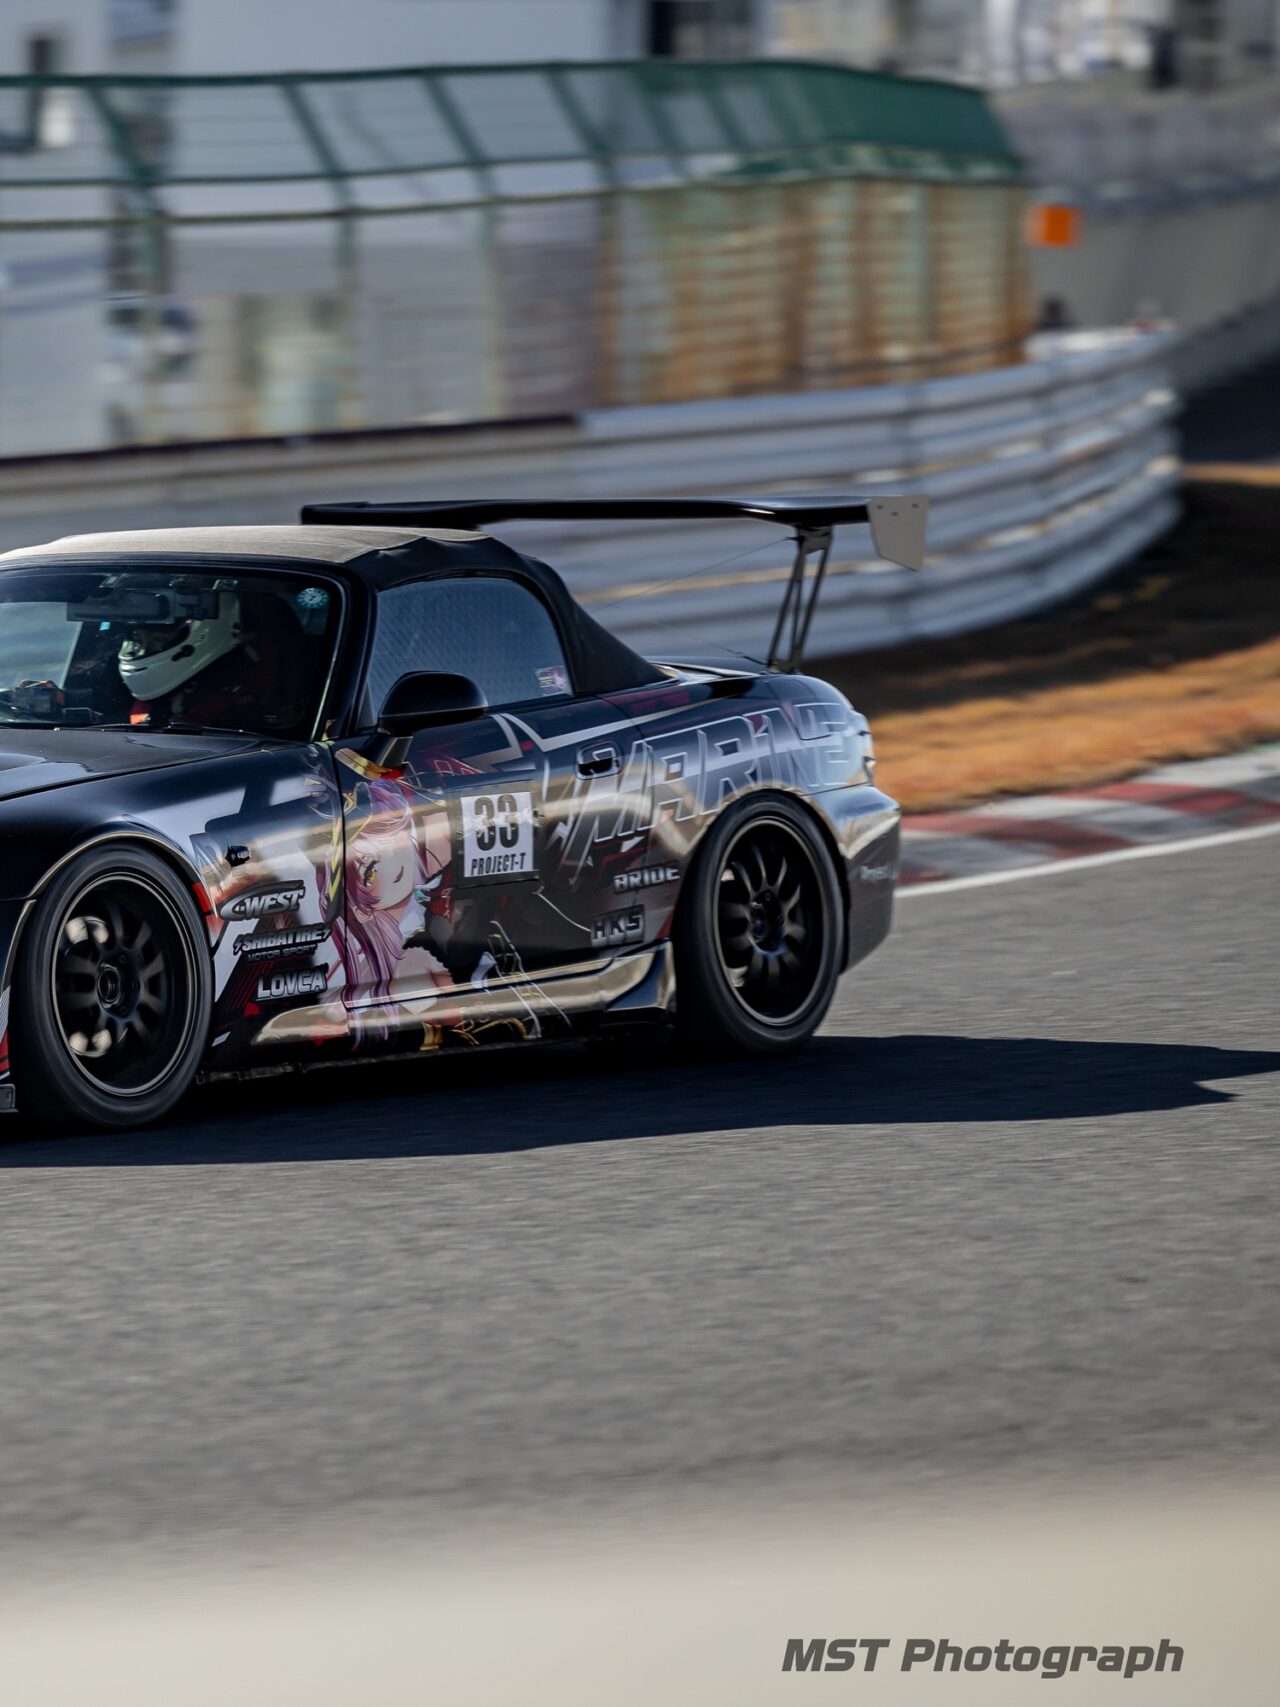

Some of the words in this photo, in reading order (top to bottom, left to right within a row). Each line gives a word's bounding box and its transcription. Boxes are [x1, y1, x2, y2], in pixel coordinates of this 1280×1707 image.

[474, 793, 519, 852] 33
[470, 852, 526, 876] PROJECT-T
[220, 879, 305, 919] C-WEST
[242, 928, 322, 952] SHIBATIRE
[593, 914, 642, 941] HKS
[257, 970, 326, 998] LOVCA
